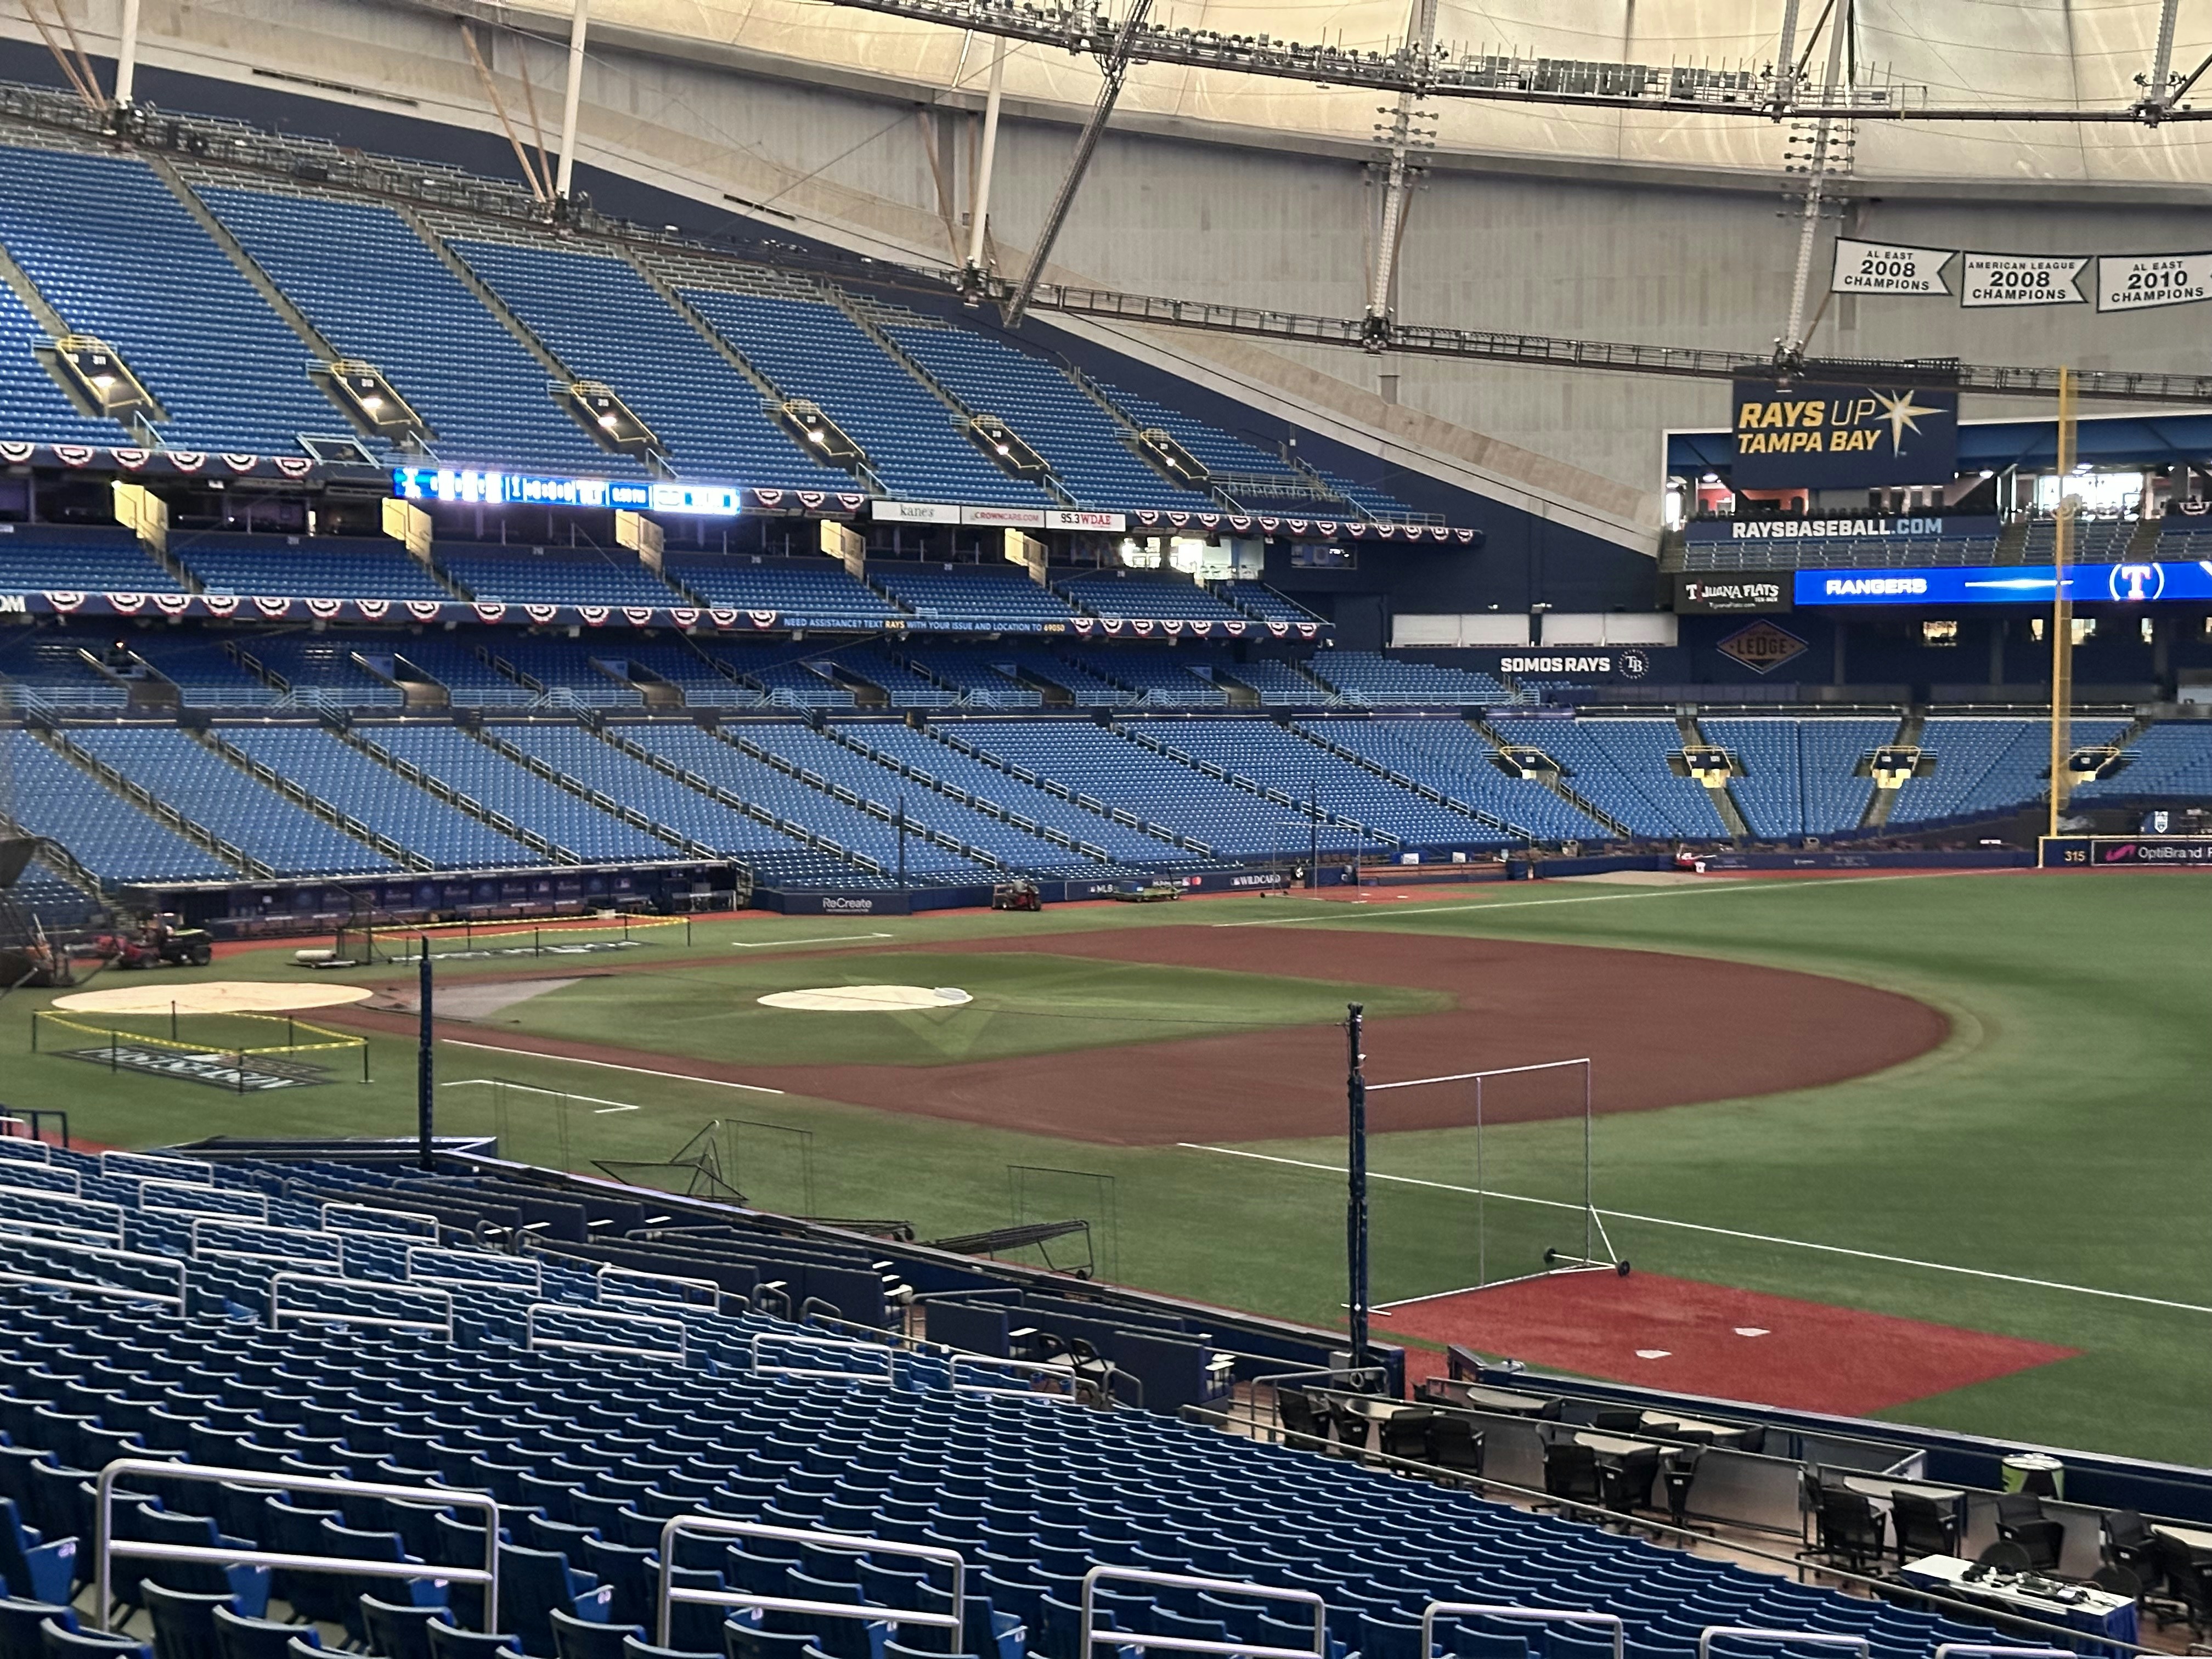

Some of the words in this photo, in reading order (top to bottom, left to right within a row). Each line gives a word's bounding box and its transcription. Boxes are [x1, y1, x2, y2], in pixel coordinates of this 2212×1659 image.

[1884, 252, 1913, 261] EAST
[1861, 259, 1916, 278] 2008
[1968, 261, 2027, 270] AMERICAN
[2031, 262, 2075, 270] LEAGUE
[2134, 263, 2148, 272] AL
[2152, 261, 2182, 270] EAST
[1844, 275, 1929, 291] CHAMPIONS
[1990, 272, 2050, 288] 2008
[2128, 271, 2188, 290] 2010
[1972, 289, 2066, 300] CHAMPIONS
[2112, 287, 2204, 303] CHAMPIONS
[1739, 401, 1825, 428] RAYS
[1831, 399, 1876, 426] UP
[1738, 432, 1822, 453] TAMPA
[1830, 430, 1883, 451] BAY
[974, 511, 1039, 521] CROWNCARS.COM
[1733, 518, 1942, 538] RAYSBASEBALL.COM
[1743, 584, 1779, 597] FLATS
[1826, 578, 1927, 594] RANGERS
[784, 618, 807, 626] NEED
[809, 618, 861, 627] ASSISTANCE?
[864, 620, 883, 628] TEXT
[884, 620, 905, 629] RAYS
[929, 622, 950, 630] YOUR
[1737, 636, 1787, 656] LEDGE
[2064, 850, 2085, 861] 315
[823, 898, 872, 909] ReCreate
